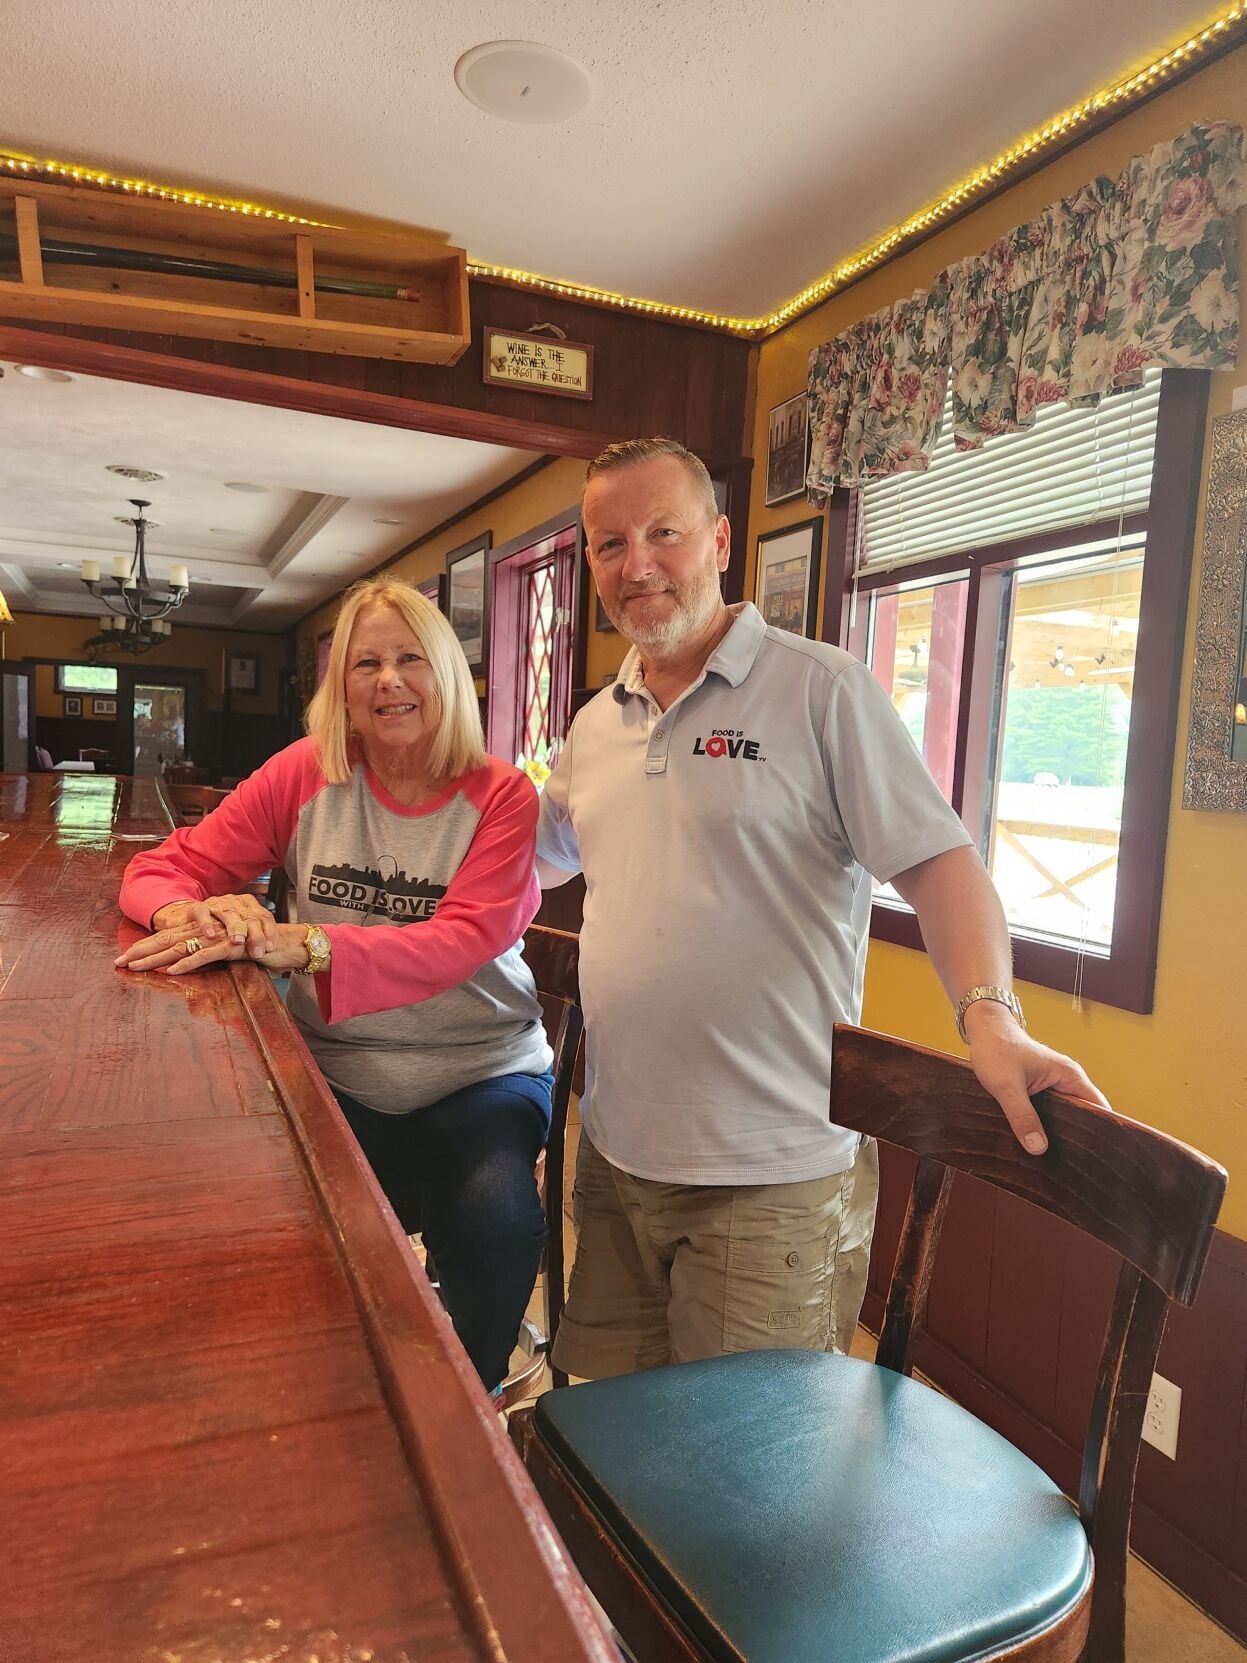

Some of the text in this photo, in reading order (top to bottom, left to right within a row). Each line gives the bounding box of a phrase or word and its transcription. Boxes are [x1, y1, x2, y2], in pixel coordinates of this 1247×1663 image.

[507, 342, 565, 362] WINE IS THE
[508, 365, 582, 387] FORGOT THE QUESTION
[556, 362, 564, 373] I
[693, 737, 760, 760] LOVE
[309, 876, 436, 915] FOOD IS OVE
[339, 900, 365, 911] WITH
